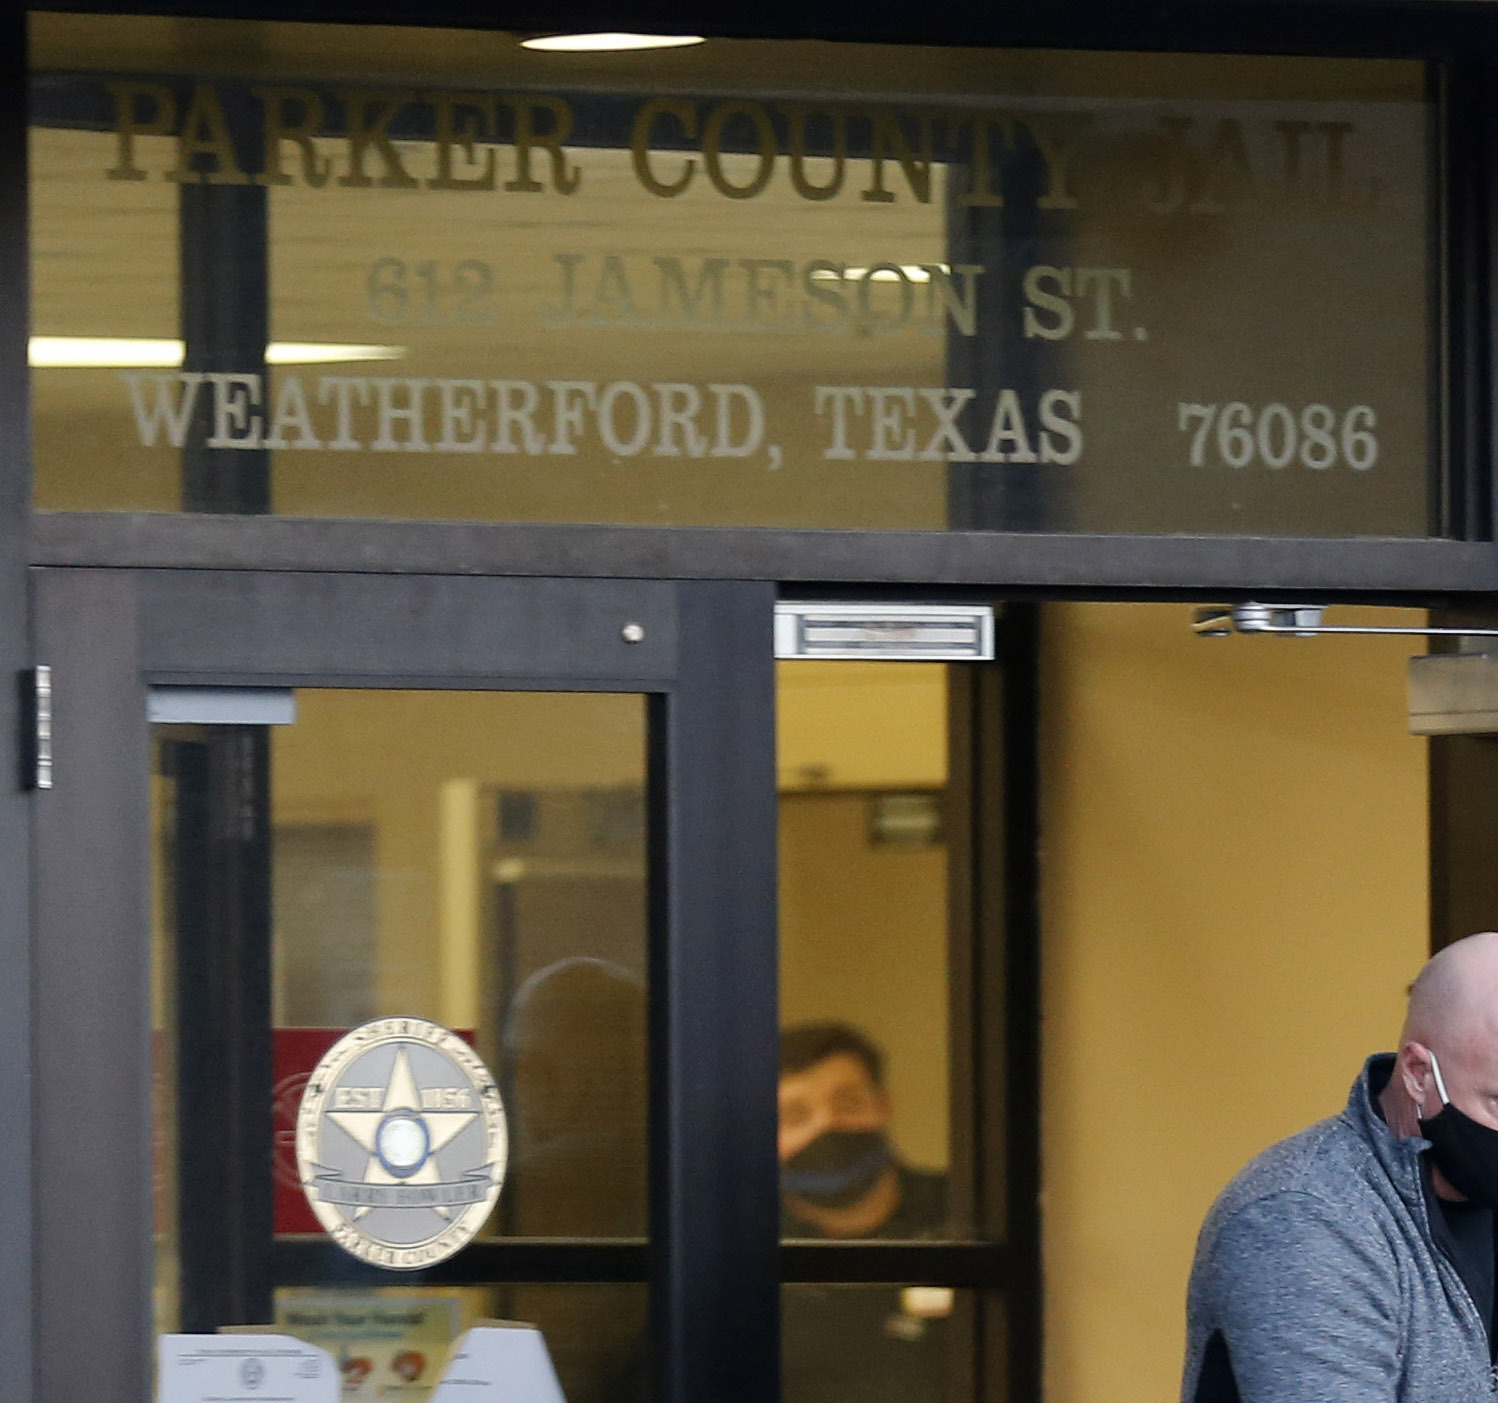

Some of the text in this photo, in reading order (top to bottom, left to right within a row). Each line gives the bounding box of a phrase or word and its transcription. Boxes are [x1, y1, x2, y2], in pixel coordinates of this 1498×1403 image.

[105, 81, 1383, 215] PARKER COUNTY JAIL
[366, 253, 1148, 341] 612 JAMESON ST.
[118, 372, 1379, 471] WEATHERFORD, TEXAS 76086
